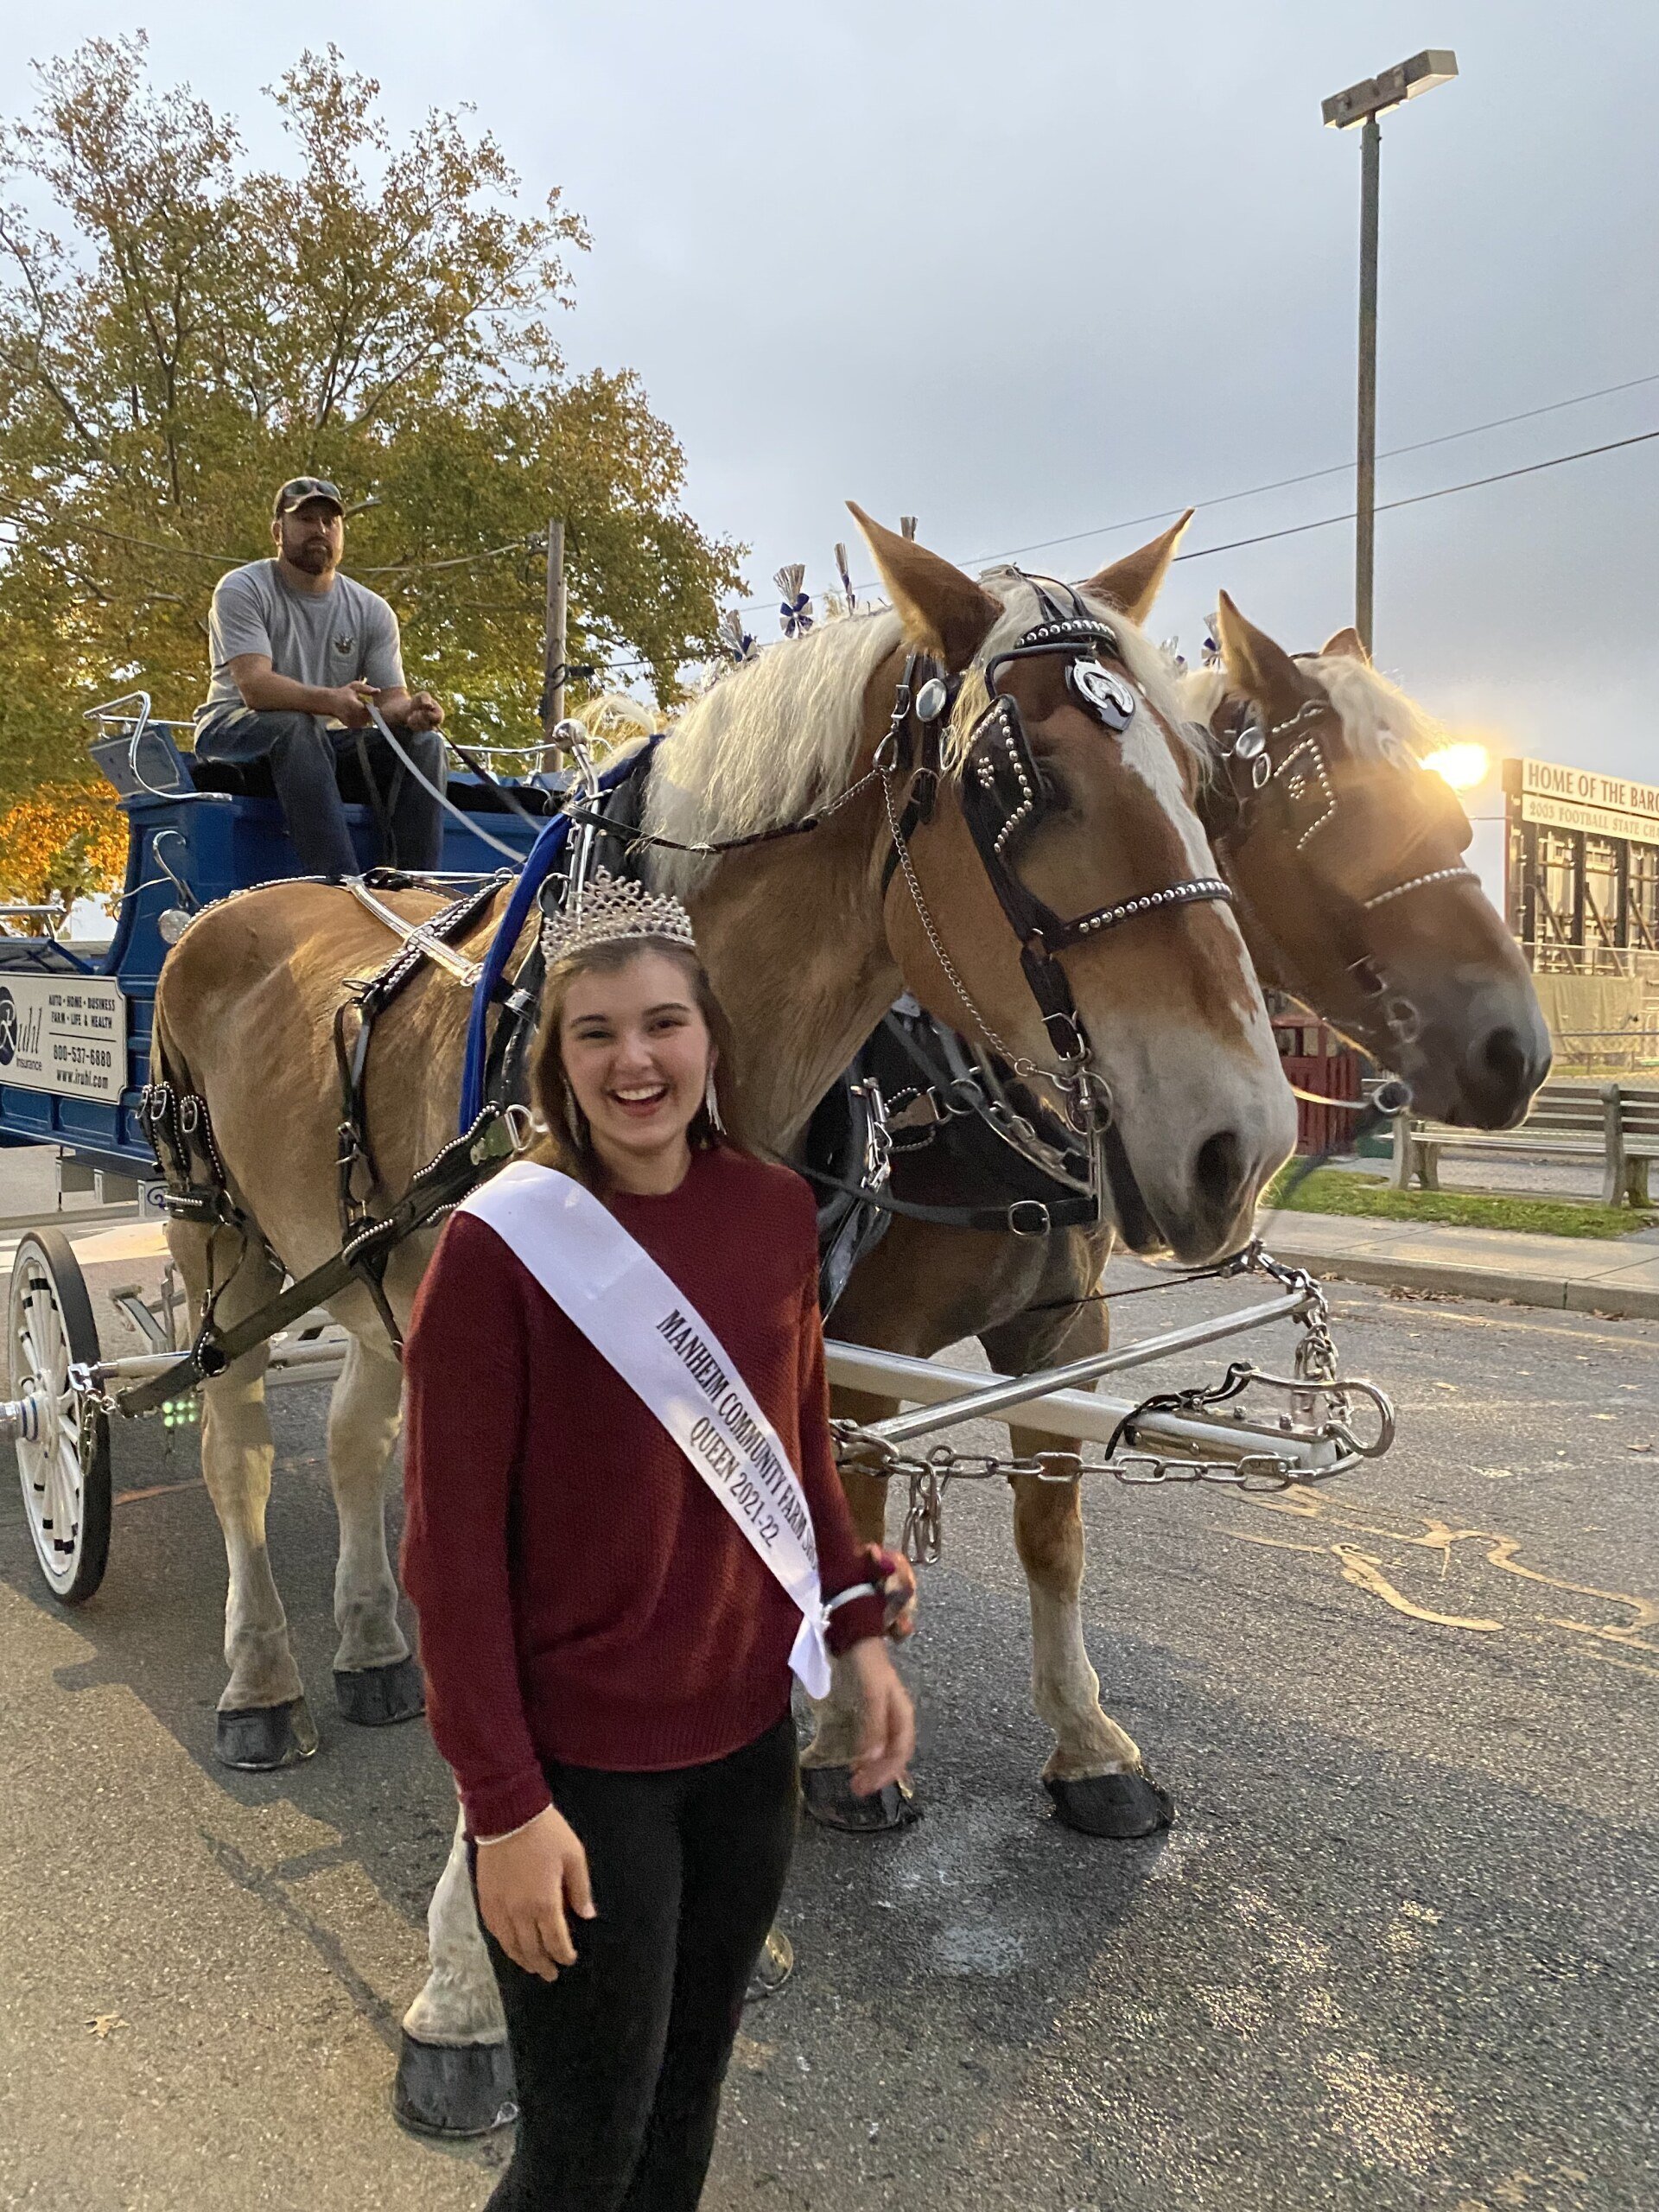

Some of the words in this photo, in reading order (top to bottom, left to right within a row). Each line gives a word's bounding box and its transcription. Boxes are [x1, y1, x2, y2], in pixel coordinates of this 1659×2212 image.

[1529, 763, 1573, 794] HOME
[1578, 774, 1596, 799] OF
[1600, 780, 1626, 805] THE
[1529, 801, 1554, 819] 2003
[1559, 807, 1609, 830] FOOTBALL
[1612, 817, 1640, 836] STATE
[48, 994, 62, 1007] AUTO
[67, 995, 82, 1008] HOME
[87, 997, 115, 1012] BUSINESS
[51, 1011, 66, 1024] FARM
[70, 1013, 81, 1027] LIFE
[84, 1014, 88, 1027] &
[91, 1015, 112, 1029] HEALTH
[16, 1056, 42, 1071] Insurance
[54, 1044, 111, 1068] 800-537-6880
[56, 1068, 109, 1090] www.iruhl.com
[656, 1309, 729, 1403] MANHEIM
[718, 1392, 787, 1496] COMMUNITY
[777, 1484, 807, 1541] FARM
[690, 1416, 741, 1483] QUEEN
[729, 1471, 780, 1548] 2021-22
